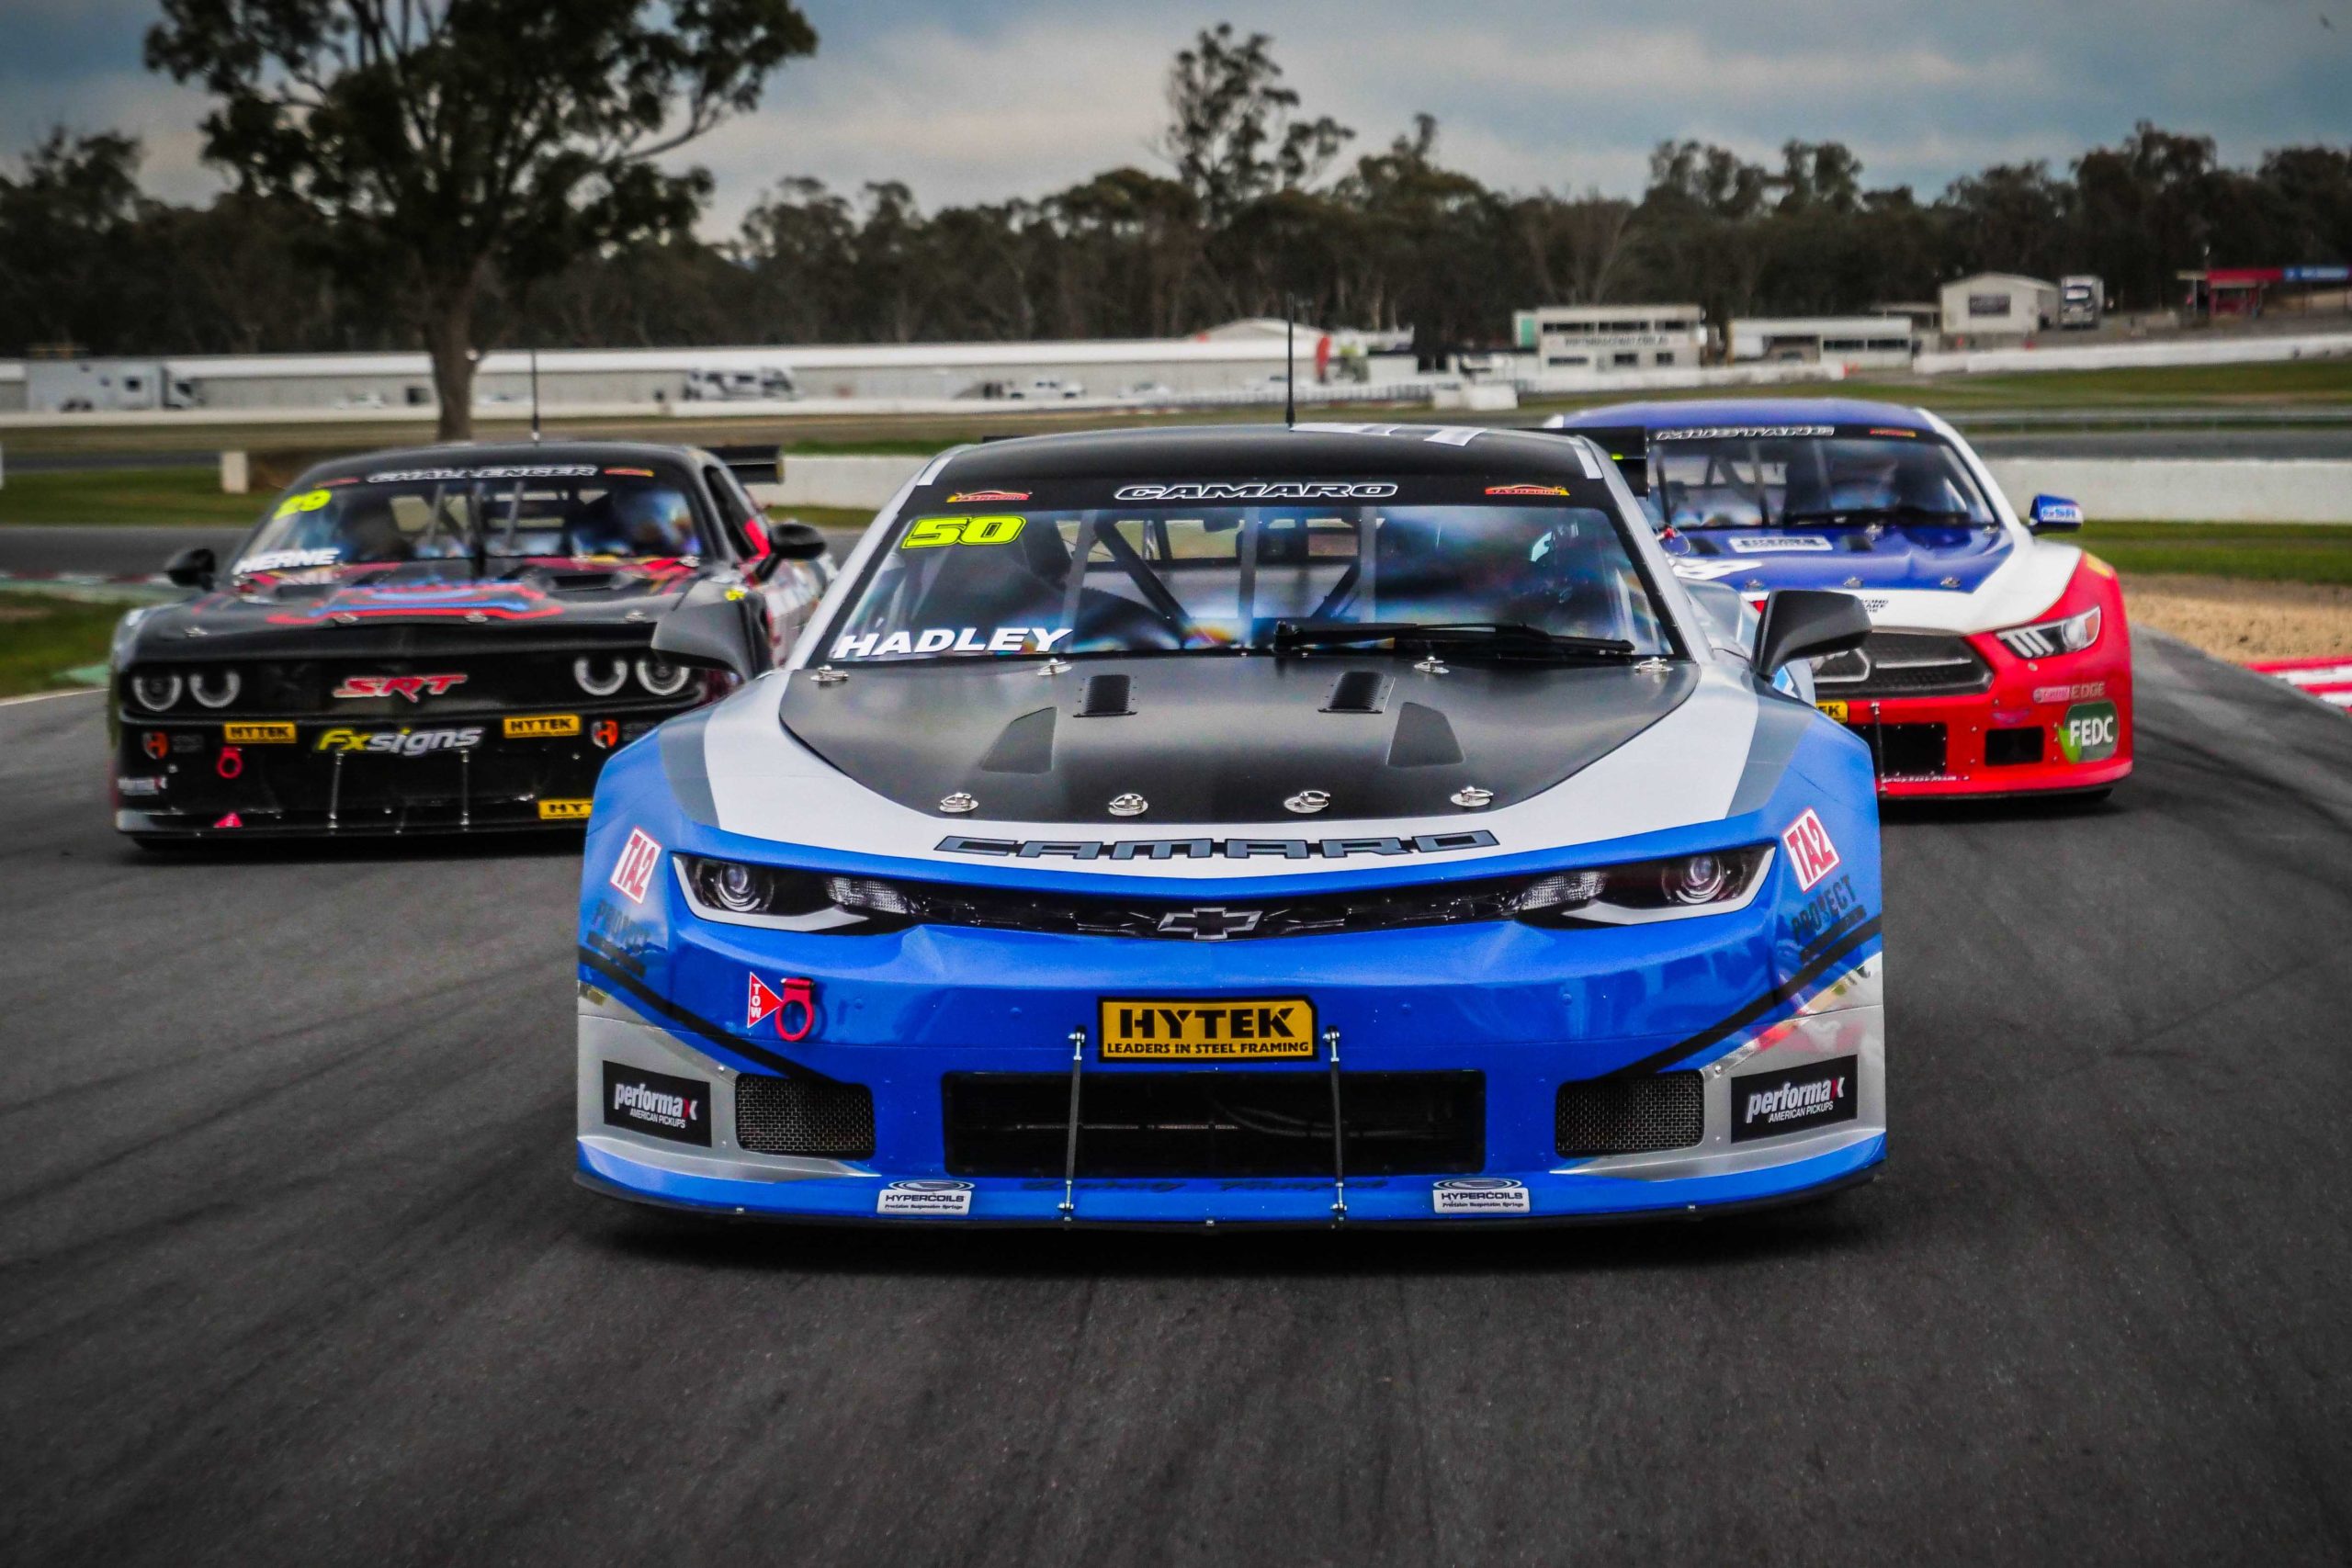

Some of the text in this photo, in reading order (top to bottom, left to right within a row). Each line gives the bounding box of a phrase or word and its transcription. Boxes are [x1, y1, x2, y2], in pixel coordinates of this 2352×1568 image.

[368, 463, 598, 483] CHALLENGER
[1114, 482, 1398, 501] CAMARO
[900, 514, 1028, 549] 50
[833, 626, 1074, 660] HADLEY
[332, 673, 468, 704] SRT
[2070, 681, 2106, 699] EDGE
[231, 726, 289, 738] HYTEK
[511, 717, 573, 732] HYTEK
[2069, 715, 2114, 748] FEDC
[314, 727, 486, 757] Fxsigns
[933, 829, 1501, 860] CAMARO
[1786, 815, 1837, 885] TA2
[616, 833, 658, 900] TA2
[750, 983, 763, 1019] TOW
[1119, 1007, 1295, 1039] HYTEK
[1107, 1042, 1309, 1054] LEADERS IN STEEL FRAMING
[614, 1083, 698, 1121] performax
[1746, 1077, 1846, 1124] performax
[1768, 1101, 1834, 1123] AMERICAN PICKUPS
[629, 1108, 686, 1129] AMERICAN PICKUPS
[885, 1194, 965, 1202] HYPERCOILS
[1441, 1191, 1523, 1201] HYPERCOILS
